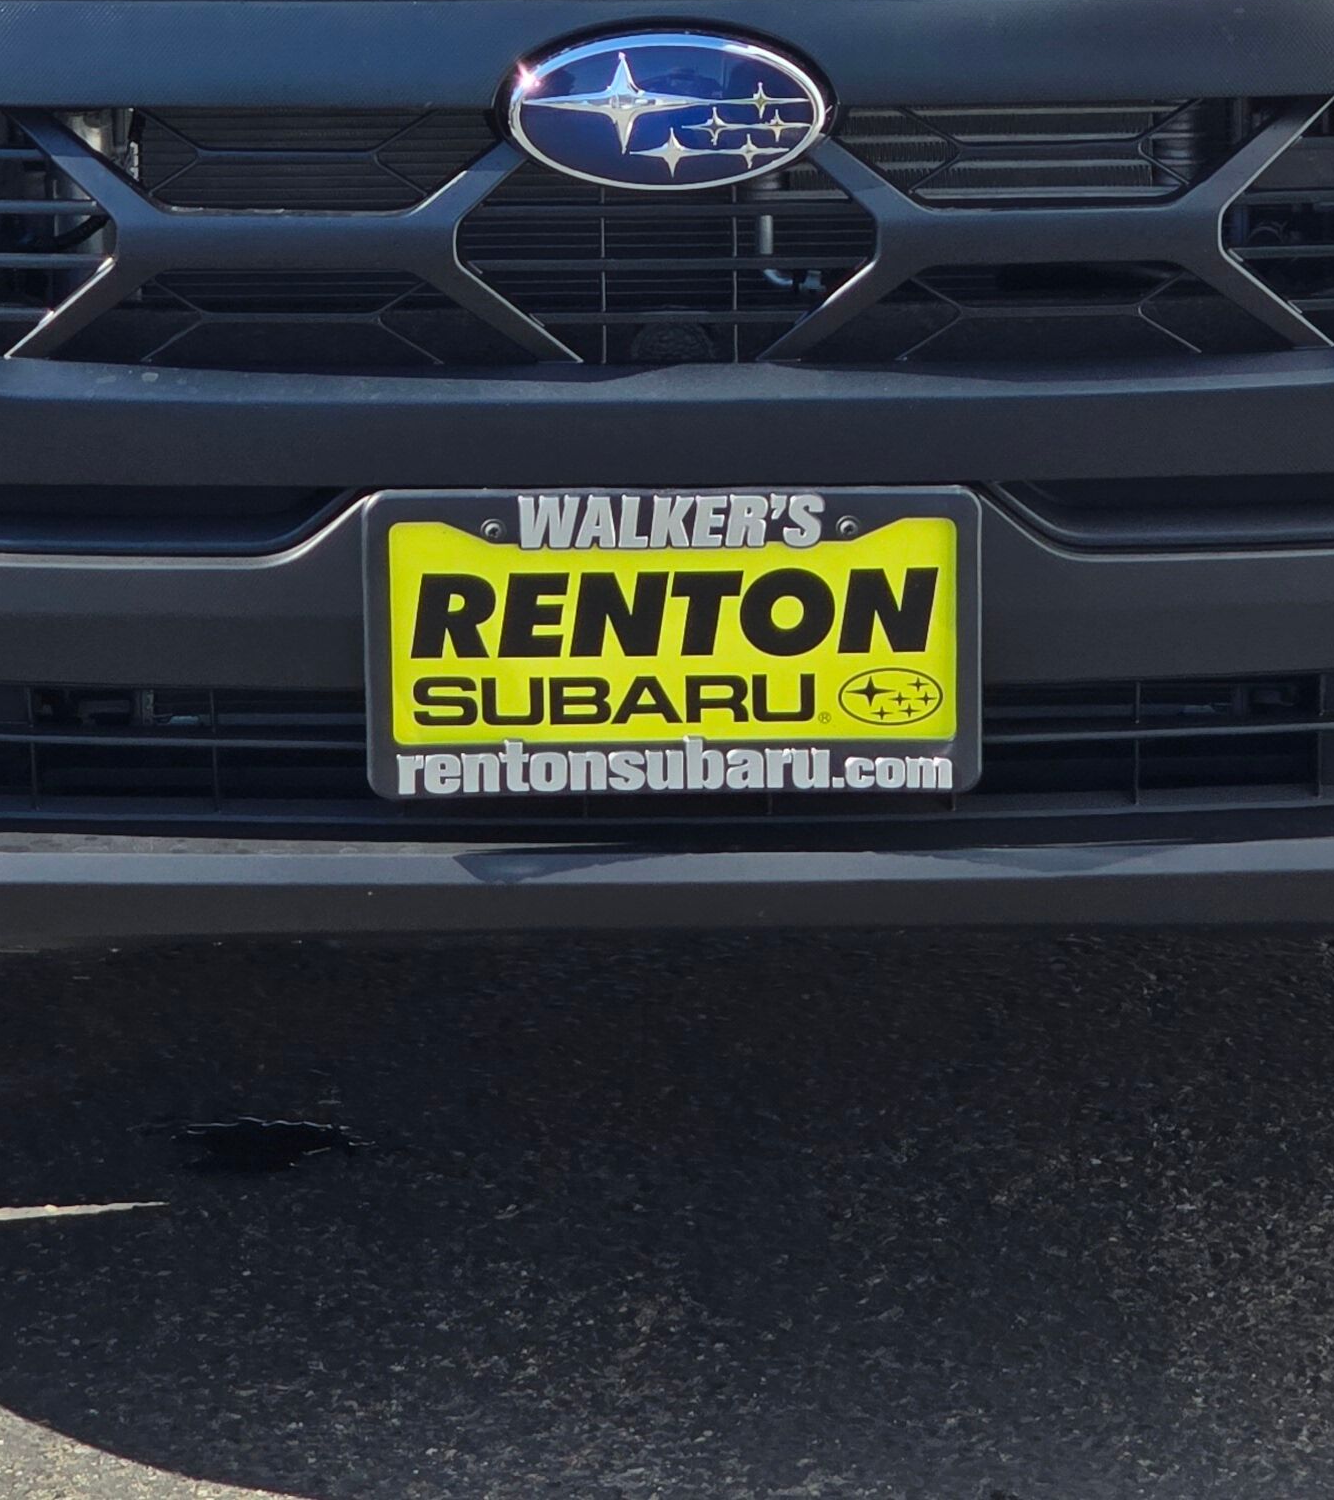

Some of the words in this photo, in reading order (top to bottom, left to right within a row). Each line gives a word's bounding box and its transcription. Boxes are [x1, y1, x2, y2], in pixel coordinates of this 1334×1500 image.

[518, 495, 825, 550] WALKER'S
[410, 566, 939, 659] RENTON
[412, 673, 815, 726] SUBARU
[396, 737, 953, 795] rentonsubaru.com
